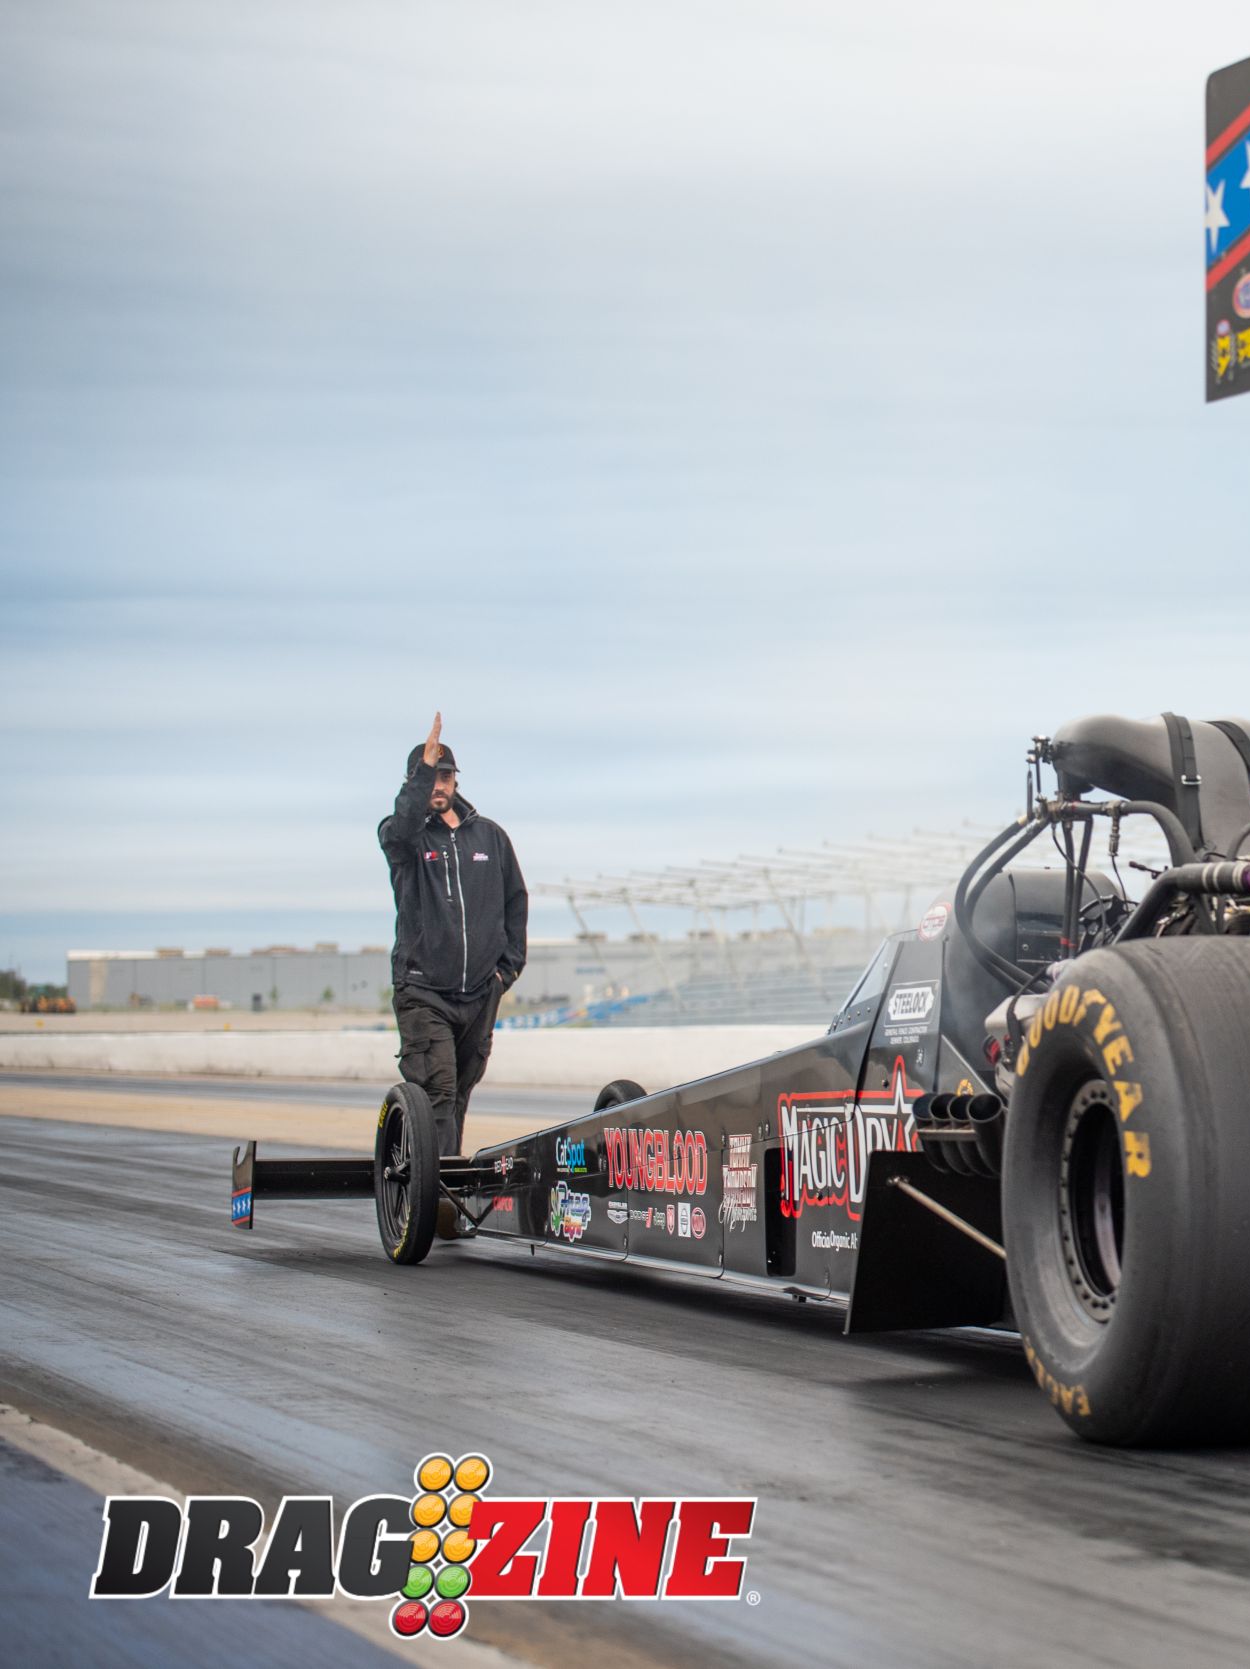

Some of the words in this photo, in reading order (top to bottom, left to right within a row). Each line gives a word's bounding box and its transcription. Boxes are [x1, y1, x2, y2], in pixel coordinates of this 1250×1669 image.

[1016, 984, 1152, 1178] GOODYEAR
[555, 1136, 587, 1171] CatSpot
[603, 1127, 708, 1196] YOUNGBLOOD
